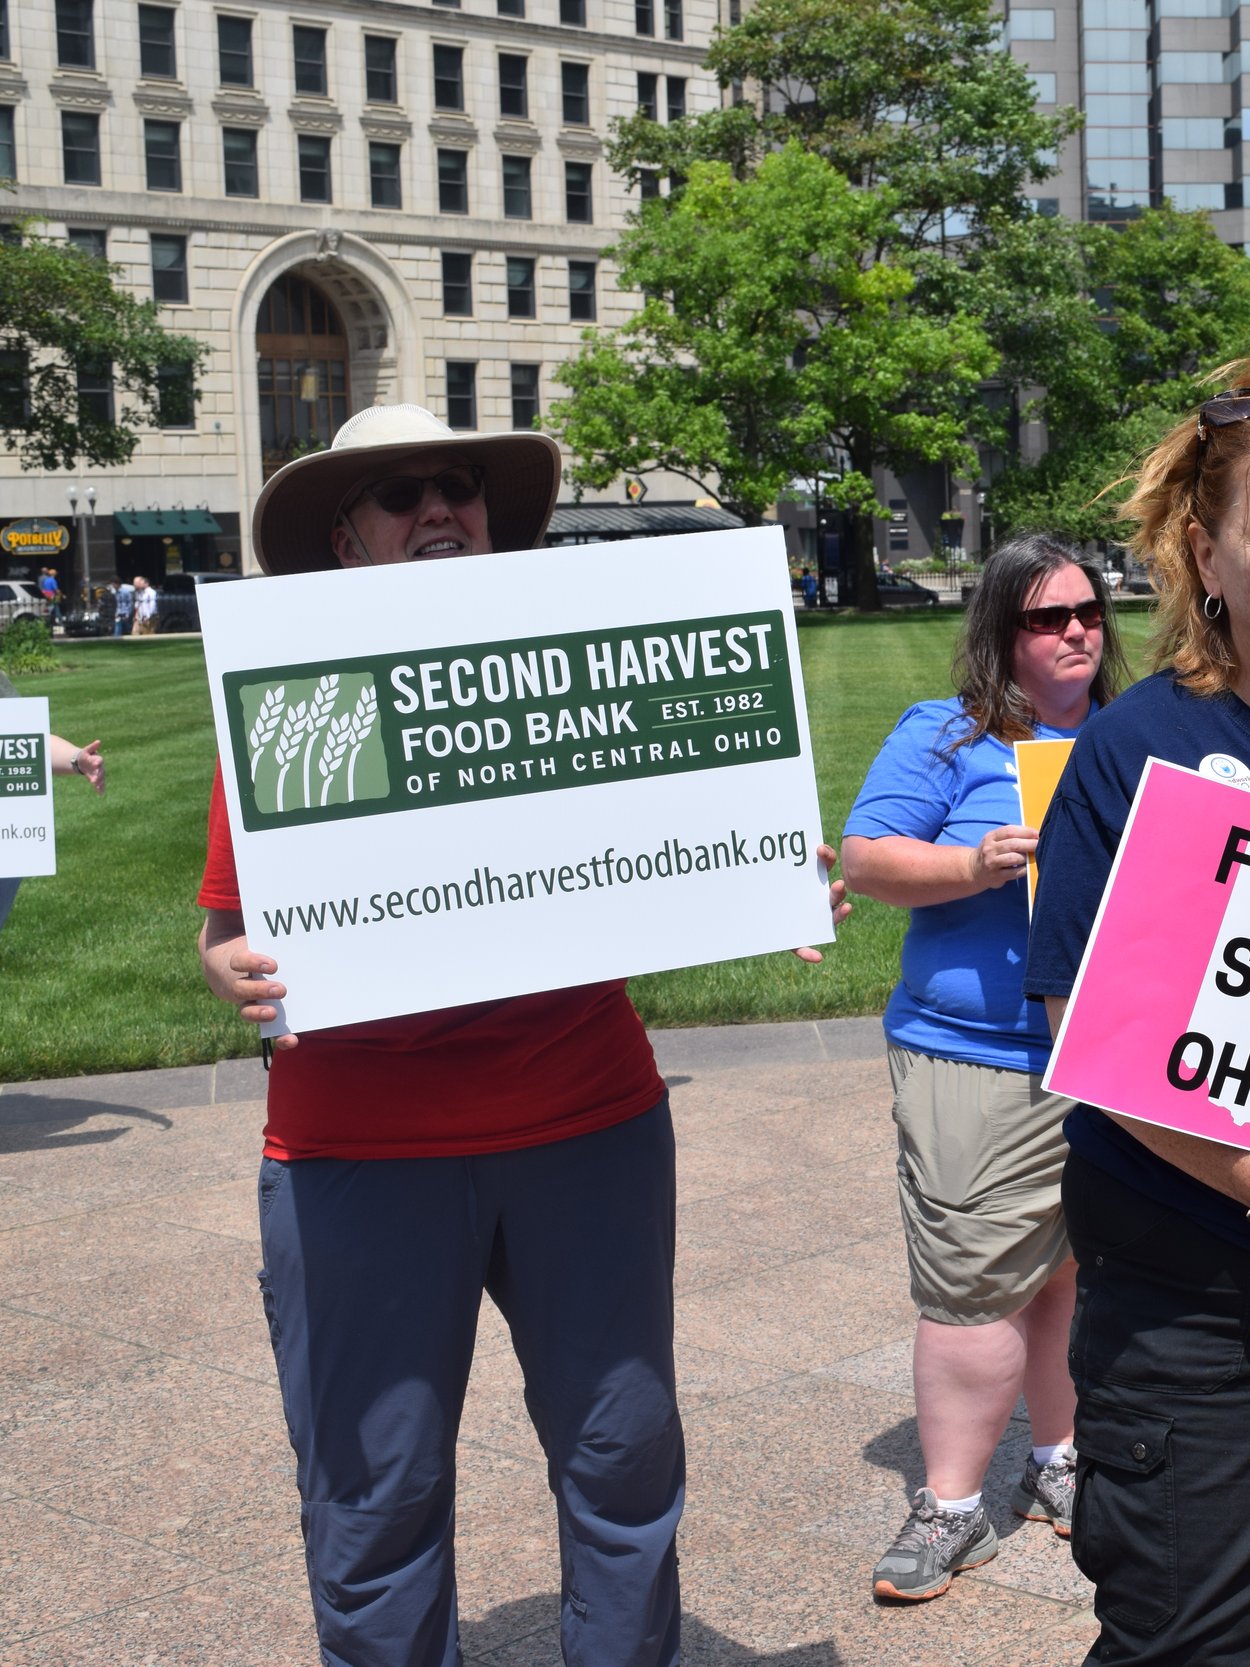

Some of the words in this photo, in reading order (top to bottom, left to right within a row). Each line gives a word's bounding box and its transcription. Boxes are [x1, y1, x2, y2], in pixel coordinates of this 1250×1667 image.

[7, 530, 63, 548] POTBELLY
[390, 648, 572, 714] SECOND
[586, 623, 772, 690] HARVEST
[661, 701, 706, 720] EST.
[713, 692, 765, 714] 1982
[401, 719, 512, 761] FOOD
[525, 701, 638, 745] BANK
[8, 766, 32, 776] 1982
[406, 772, 441, 794] OF
[458, 757, 557, 787] NORTH
[572, 739, 701, 771] CENTRAL
[714, 727, 782, 752] OHIO
[6, 782, 39, 792] OHIO
[262, 830, 809, 938] www.secondharvestfoodbank.org
